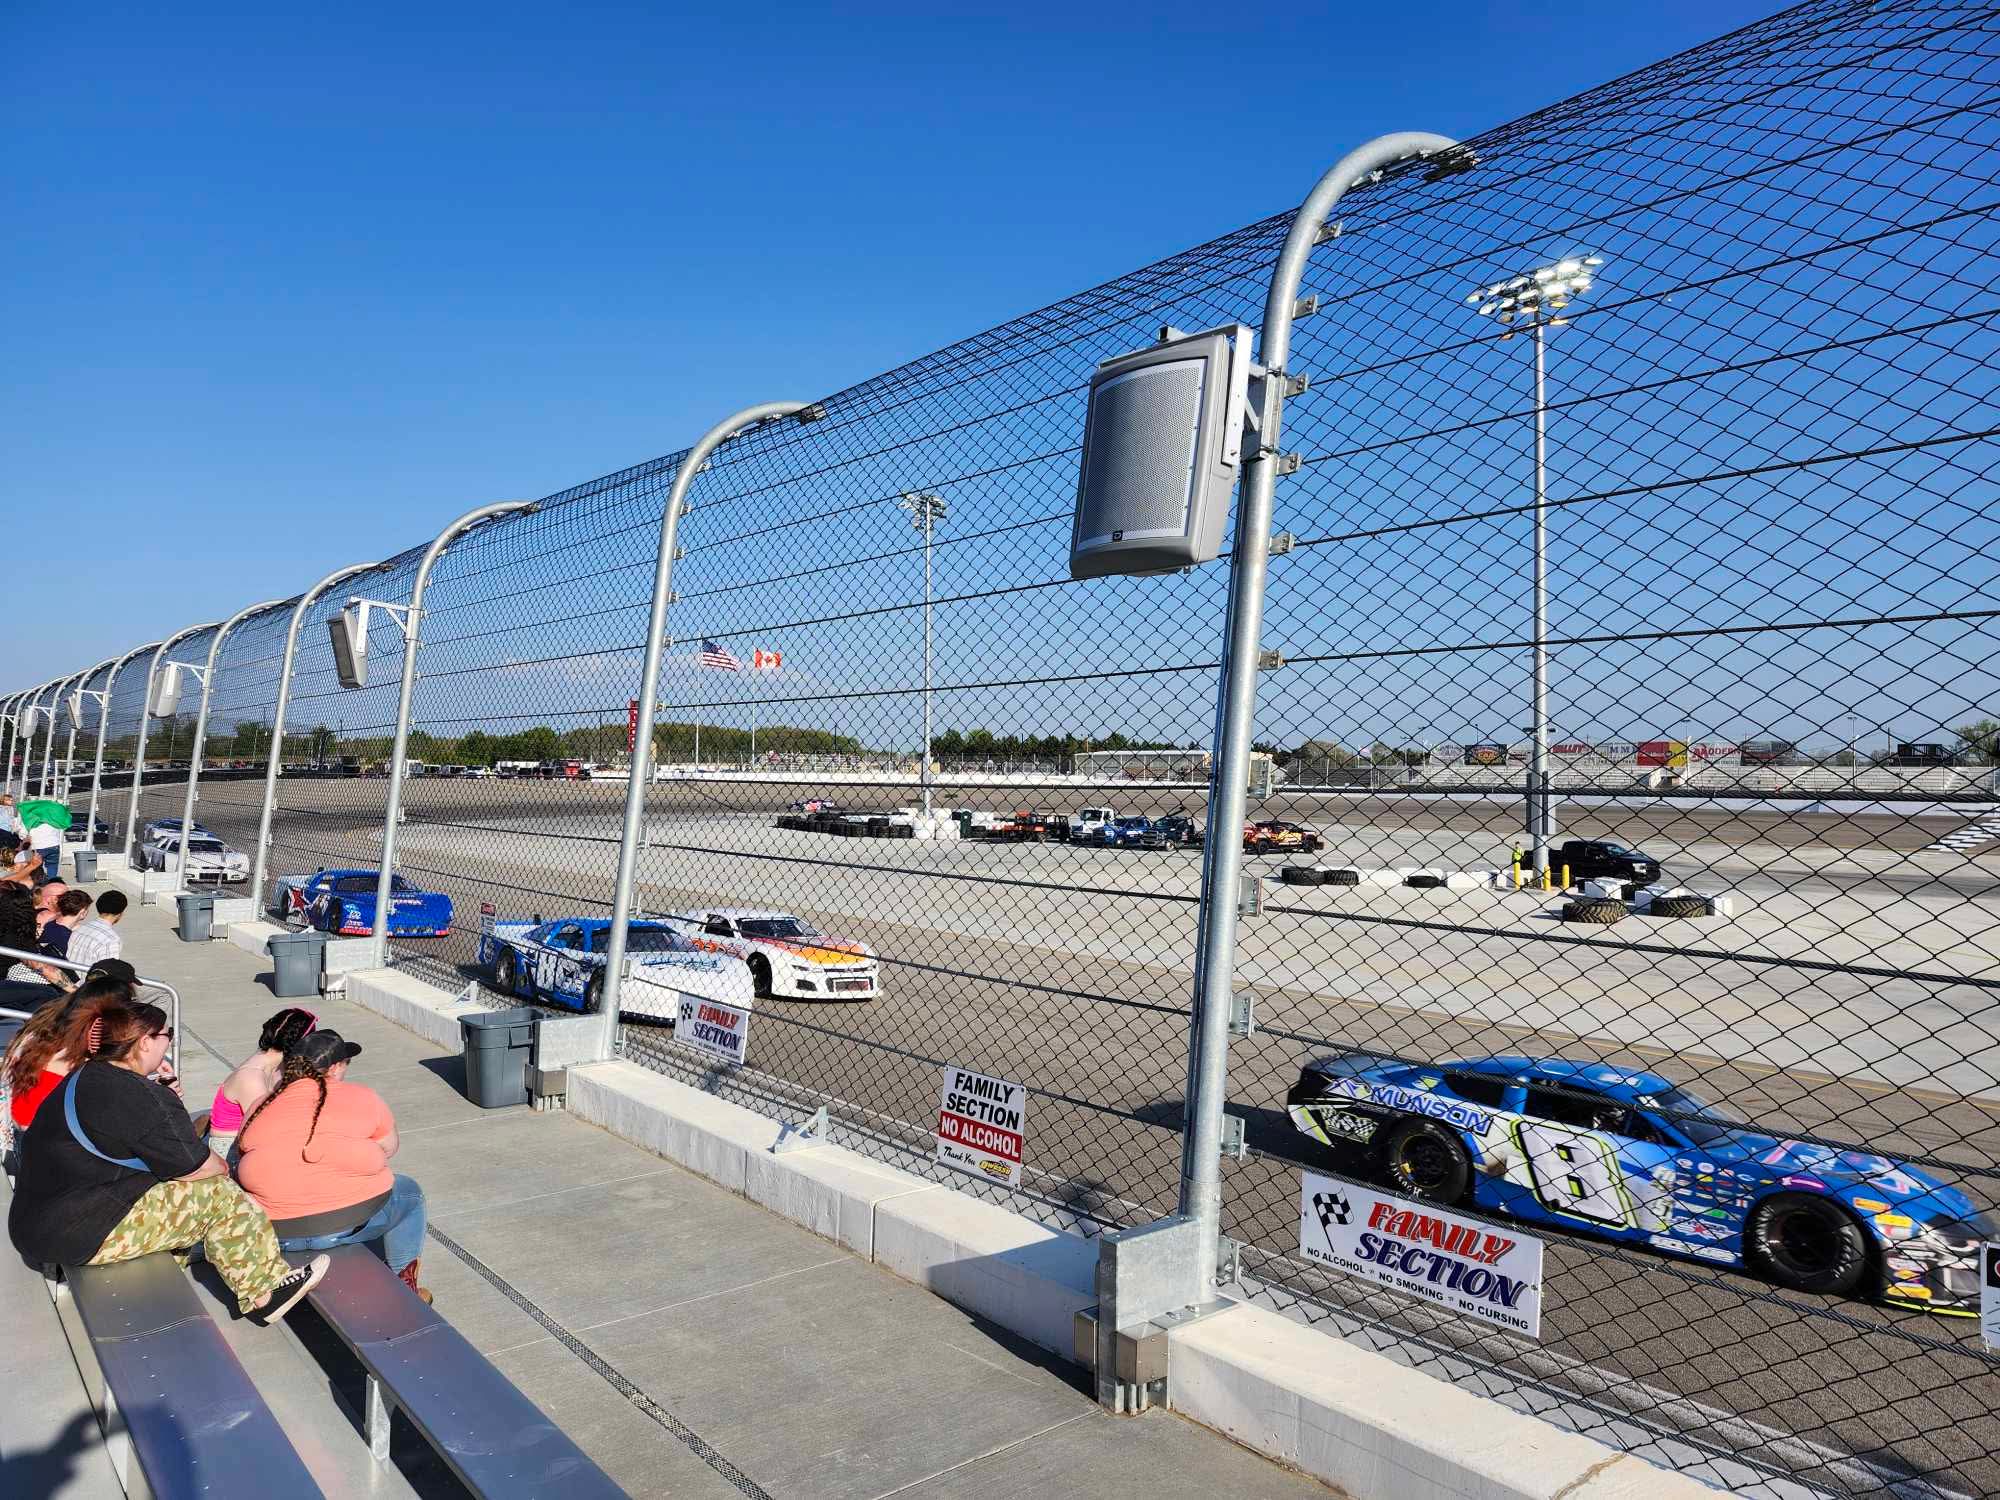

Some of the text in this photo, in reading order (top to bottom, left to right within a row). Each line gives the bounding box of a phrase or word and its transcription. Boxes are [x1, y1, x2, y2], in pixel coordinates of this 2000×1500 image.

[692, 1021, 742, 1051] SECTION
[697, 1004, 740, 1030] FAMILY
[954, 1072, 1015, 1104] FAMILY
[946, 1092, 1020, 1130] SECTION
[1370, 1086, 1491, 1135] MUNSON
[941, 1116, 1020, 1158] NO ALCOHOL
[943, 1145, 976, 1166] Thank You
[1368, 1201, 1516, 1266] FAMILY
[1307, 1247, 1529, 1330] NO ALCOHOL NO SMOKING NO CURSING
[1354, 1232, 1528, 1310] SECTION
